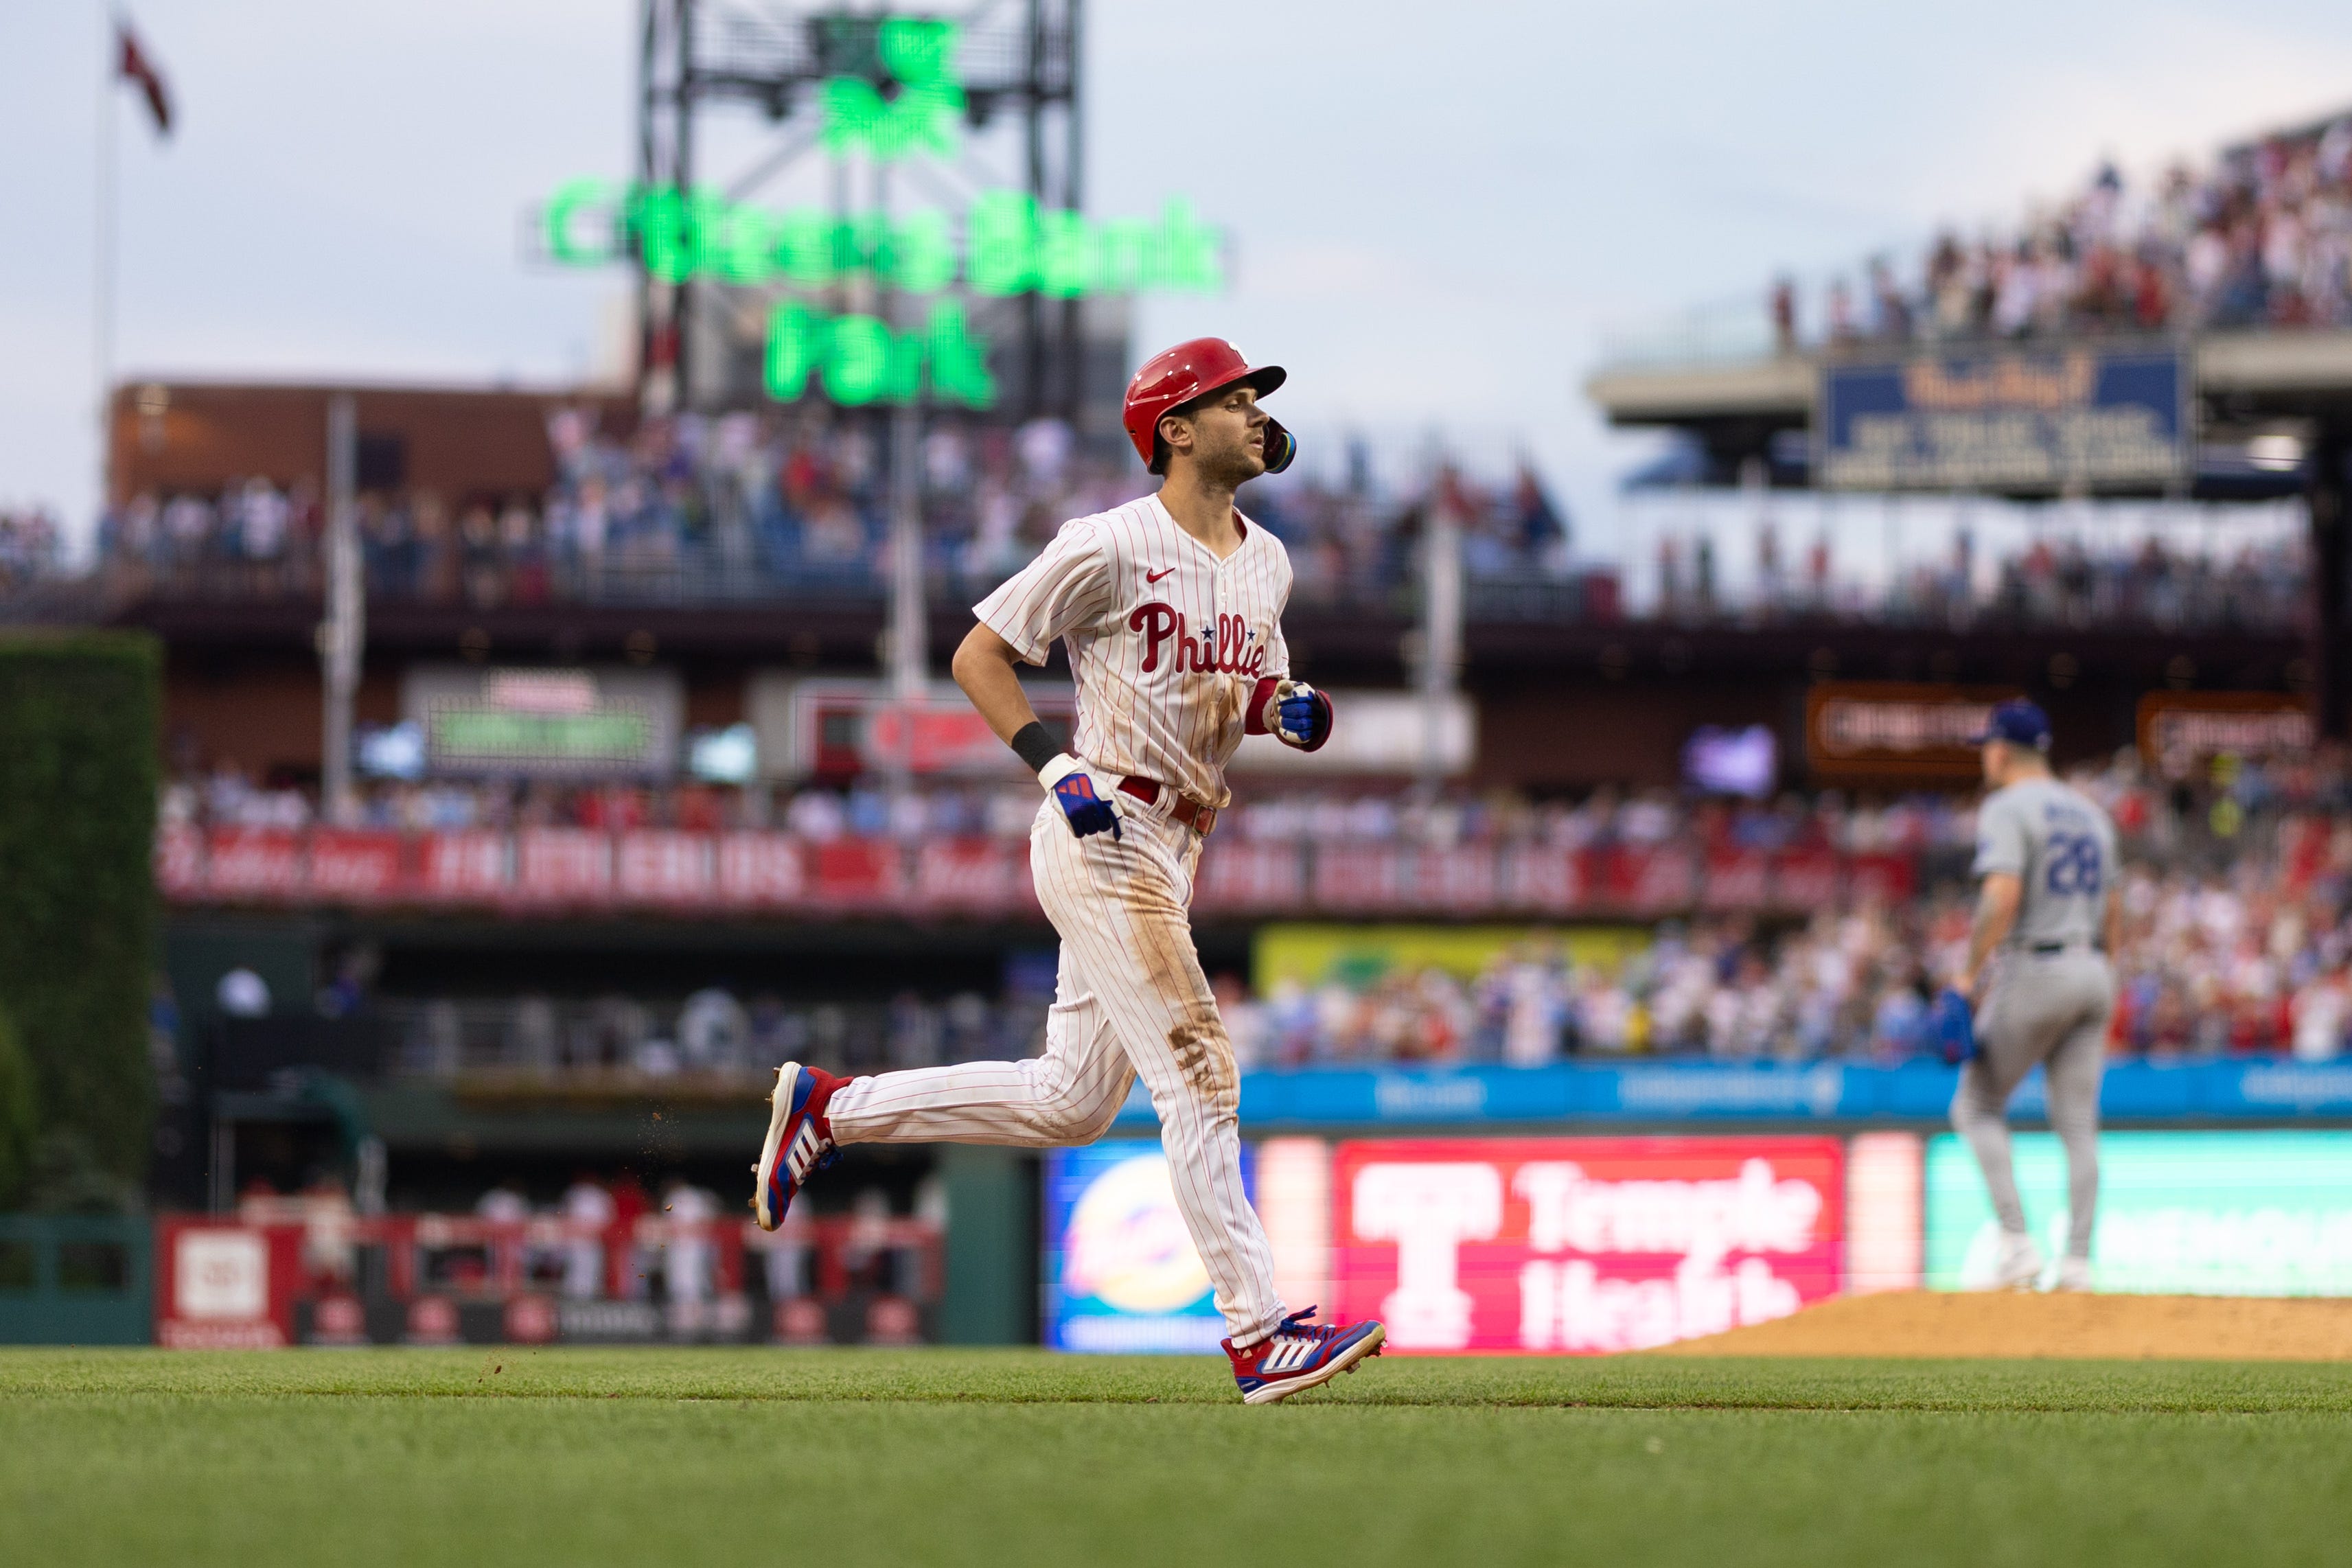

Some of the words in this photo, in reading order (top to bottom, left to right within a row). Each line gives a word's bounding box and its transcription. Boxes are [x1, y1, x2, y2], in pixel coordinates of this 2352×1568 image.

[968, 189, 1223, 298] Bank
[764, 299, 995, 408] Park
[1130, 602, 1265, 678] Phillie
[2047, 832, 2102, 898] 28
[1514, 1159, 1822, 1273] Temple
